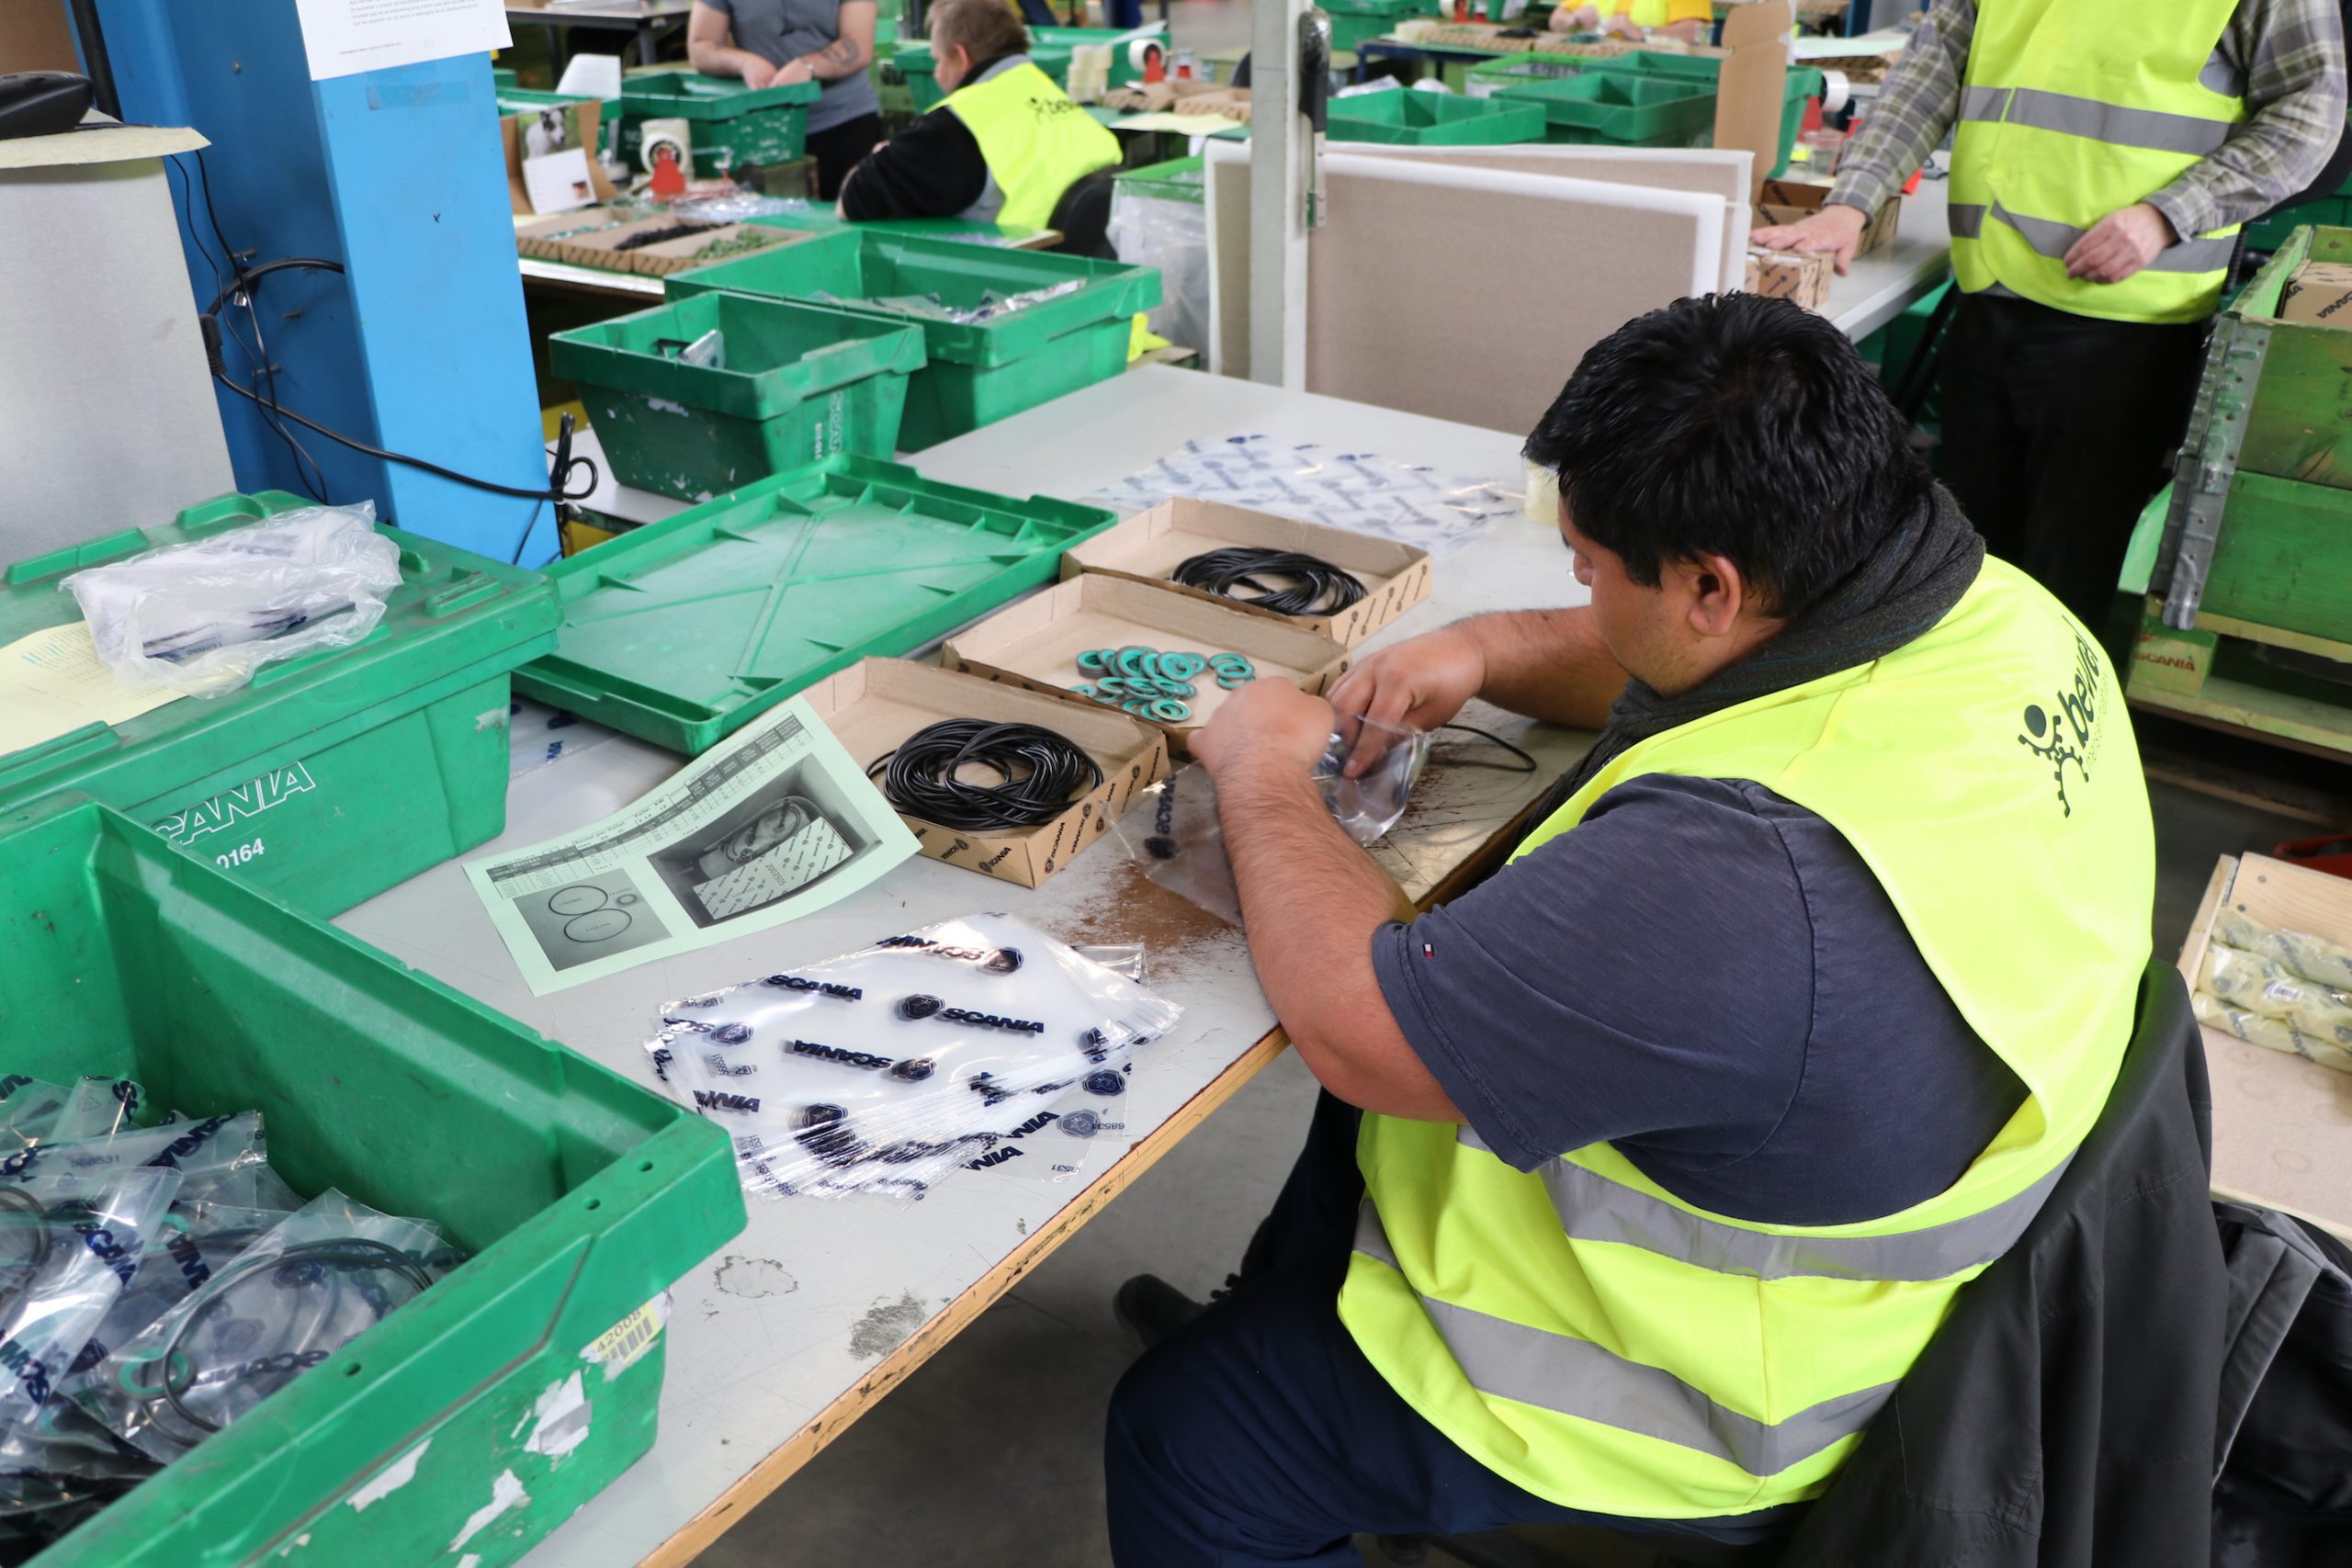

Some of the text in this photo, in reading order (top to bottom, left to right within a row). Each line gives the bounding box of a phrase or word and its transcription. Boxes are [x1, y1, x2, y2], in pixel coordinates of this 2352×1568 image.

[154, 761, 317, 845] CANIA
[988, 846, 1012, 868] SCANIA
[768, 975, 863, 999] SCANIA
[943, 1008, 1045, 1033] SCANIA
[794, 1039, 895, 1068] SCANIA
